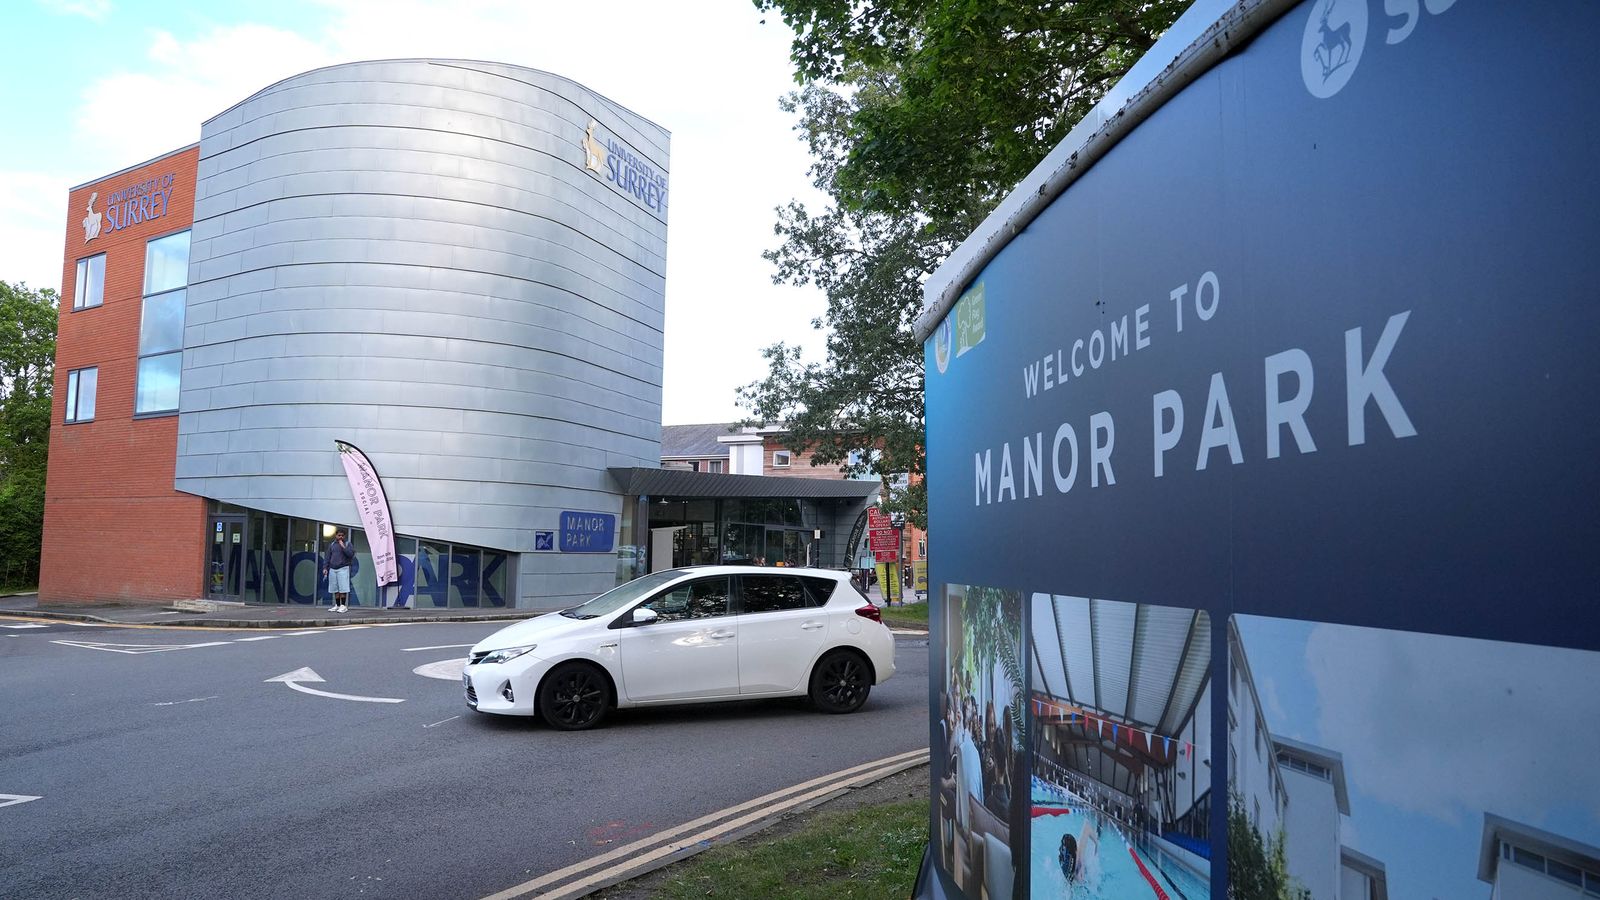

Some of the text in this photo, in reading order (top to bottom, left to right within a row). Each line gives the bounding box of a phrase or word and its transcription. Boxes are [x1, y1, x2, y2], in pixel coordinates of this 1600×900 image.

[606, 154, 666, 213] SURREY
[608, 138, 667, 189] UNIVERSITY OF
[105, 187, 173, 234] SURREY
[107, 172, 176, 206] UNIVERSITY OF
[1023, 270, 1220, 399] WELCOME TO
[974, 309, 1419, 507] MANOR PARK
[357, 462, 379, 506] MANOR
[373, 509, 389, 540] PARK
[360, 491, 371, 515] SOCIAL
[567, 516, 604, 531] MANOR
[566, 533, 592, 547] PARK
